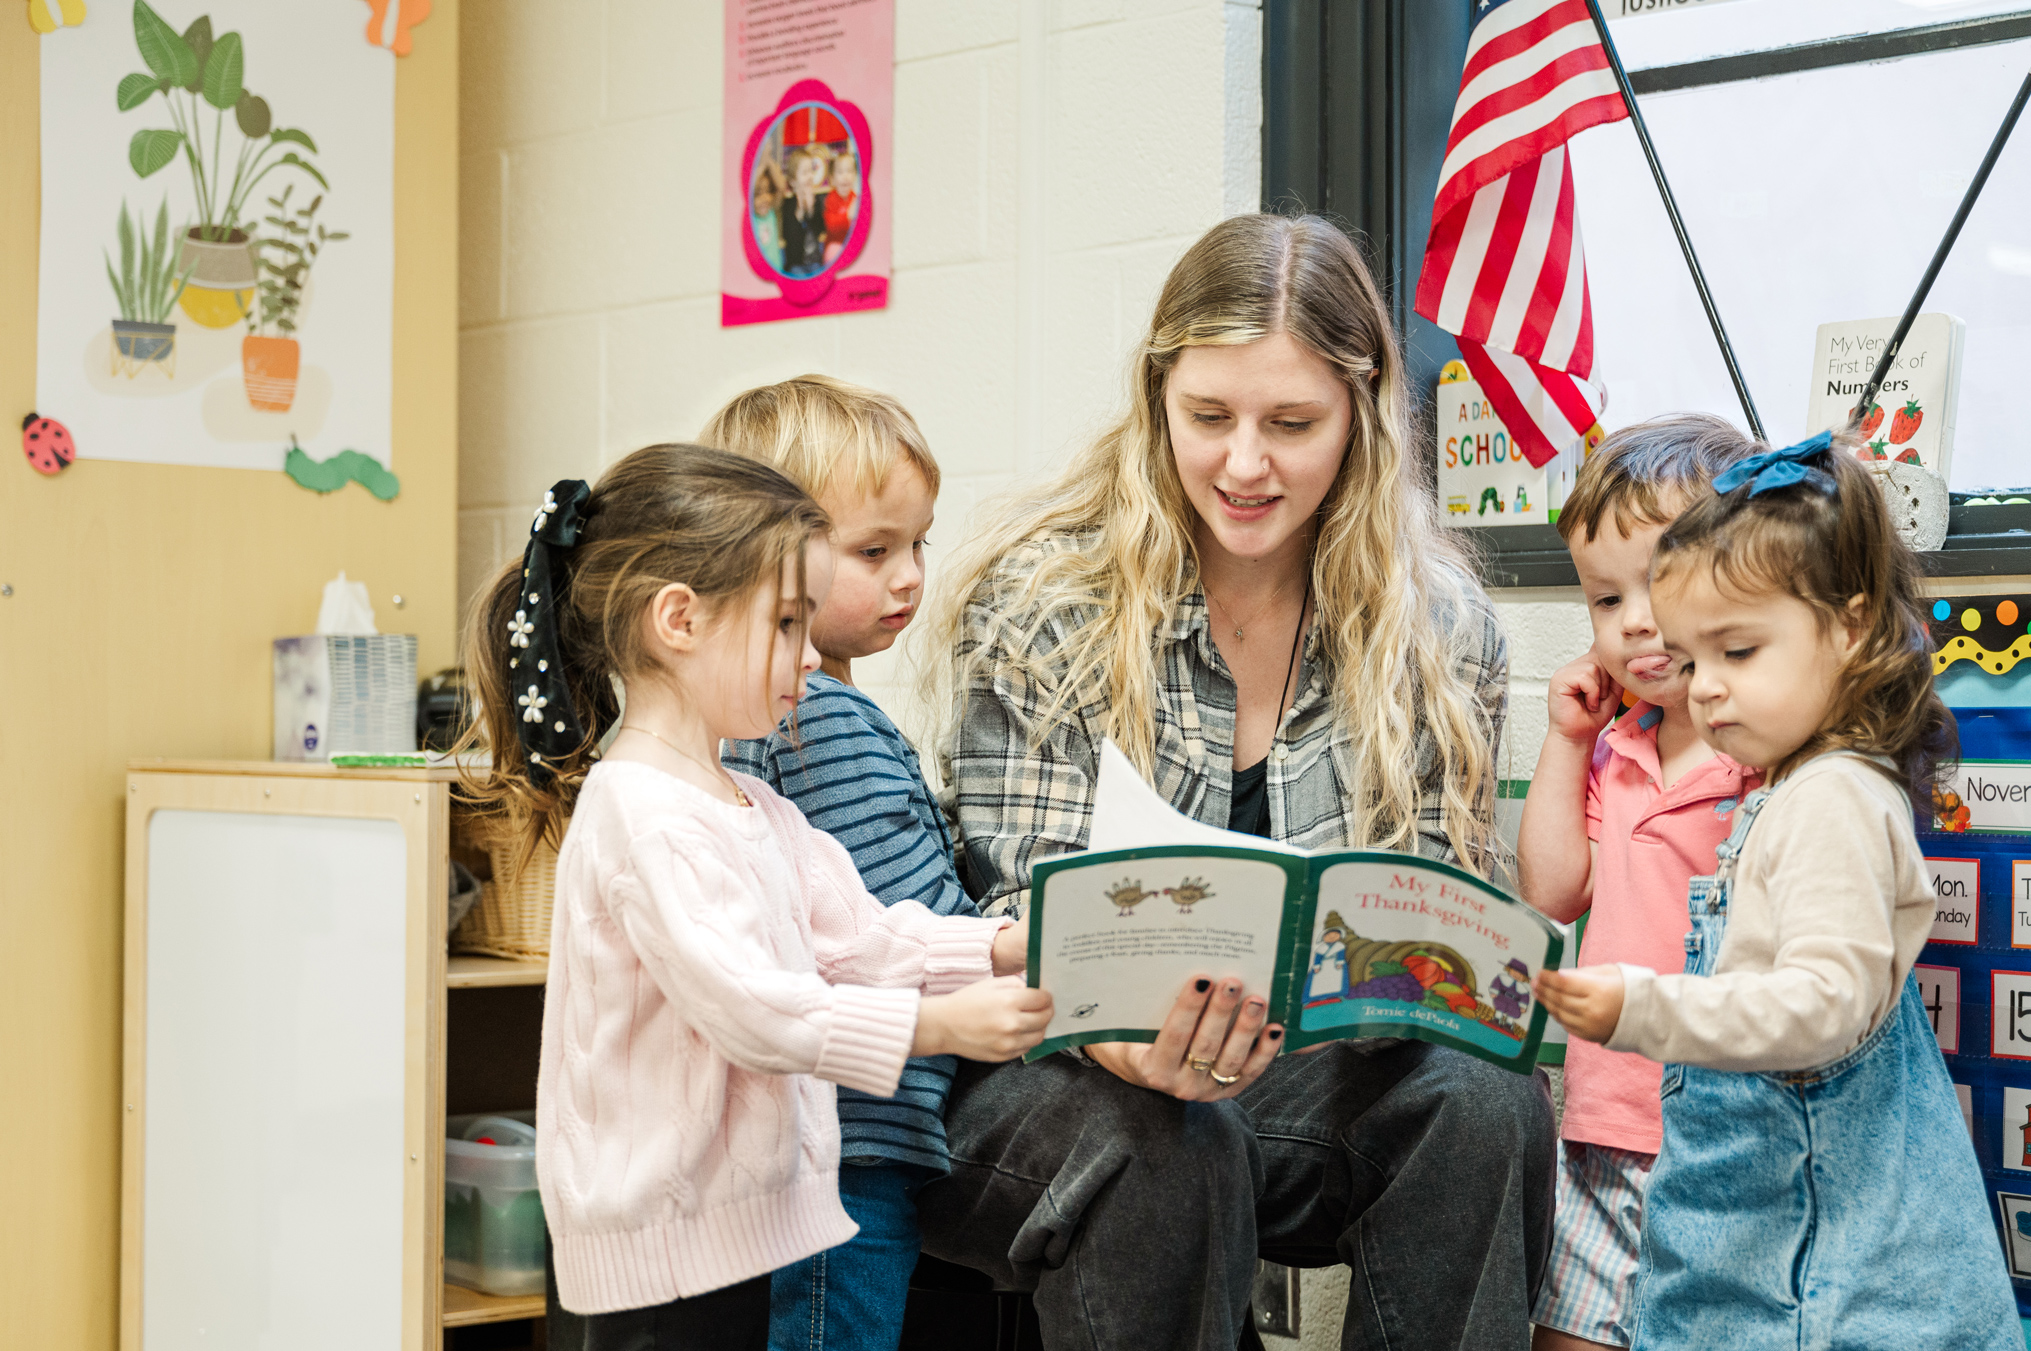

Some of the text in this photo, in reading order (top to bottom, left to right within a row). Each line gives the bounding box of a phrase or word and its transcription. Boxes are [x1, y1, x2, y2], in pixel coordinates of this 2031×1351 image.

[1831, 336, 1853, 357] My
[1829, 351, 1928, 374] First Bk of
[1827, 379, 1909, 396] Numers
[1459, 400, 1496, 422] A DA
[1445, 432, 1523, 469] SCHOO
[1389, 873, 1488, 916] My First
[1355, 893, 1511, 950] Thanksgiving
[1362, 1005, 1460, 1032] Tomie dePaola
